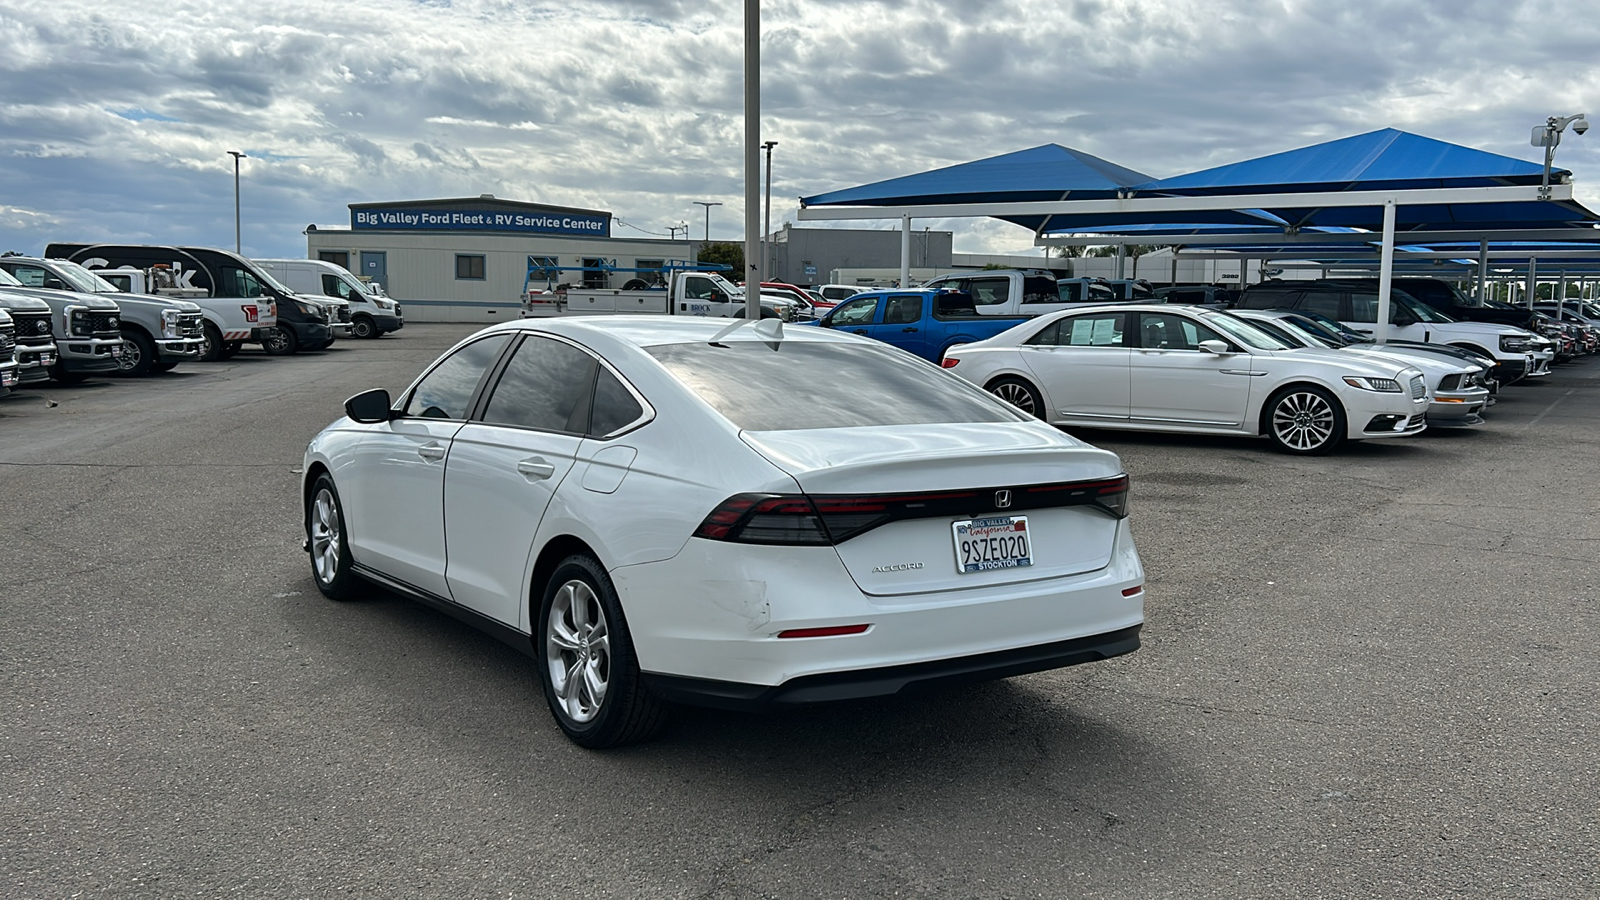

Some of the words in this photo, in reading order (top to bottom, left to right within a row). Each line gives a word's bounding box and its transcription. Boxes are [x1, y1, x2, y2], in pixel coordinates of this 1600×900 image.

[357, 212, 378, 225] Big
[380, 212, 419, 226] Valley
[421, 213, 450, 224] Ford
[452, 213, 484, 225] Fleet
[486, 216, 493, 224] &
[495, 214, 513, 226] RV
[515, 215, 560, 228] Service
[562, 218, 603, 230] Center
[691, 304, 711, 312] BROCK
[962, 535, 1027, 564] 9SZE020
[872, 562, 924, 573] ACCORD
[978, 560, 1017, 570] STOCKTON
